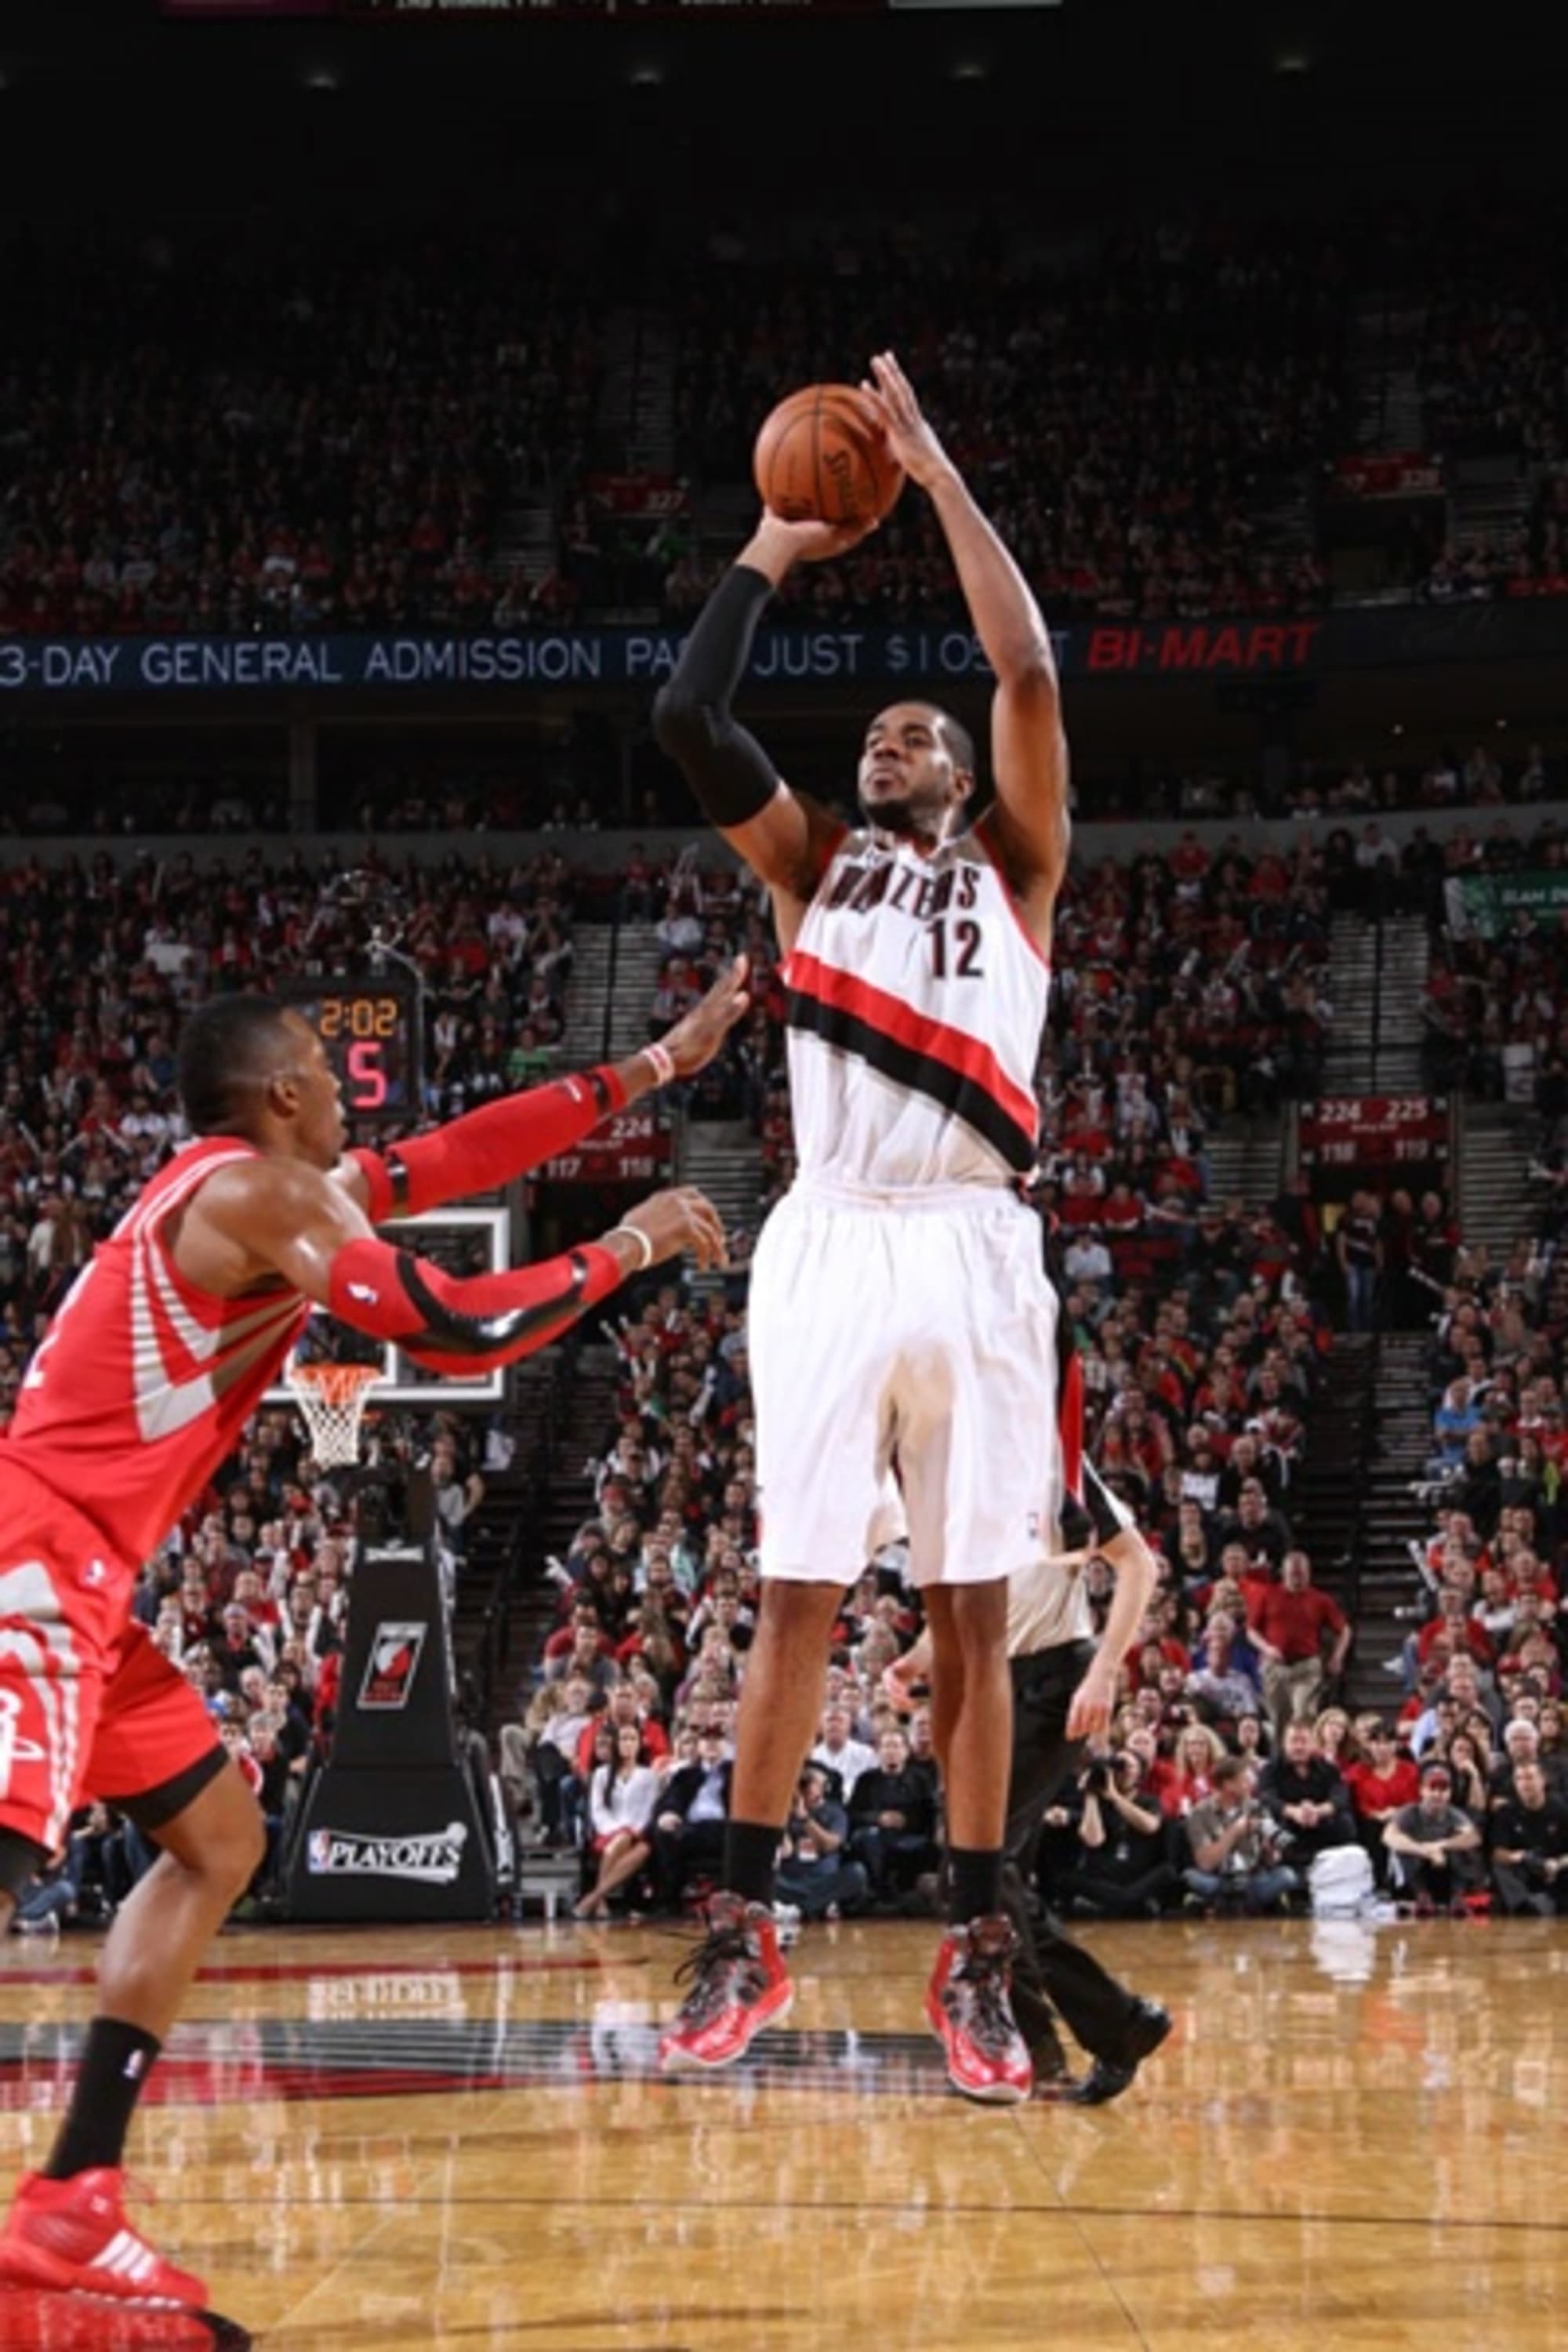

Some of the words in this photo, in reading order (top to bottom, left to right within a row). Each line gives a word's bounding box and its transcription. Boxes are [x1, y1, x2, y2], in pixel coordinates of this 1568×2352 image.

[140, 641, 343, 684] GENERAL
[364, 638, 601, 681] ADMISSION
[755, 633, 862, 676] JUST
[926, 919, 984, 978] 12
[320, 998, 397, 1036] 2:02
[348, 1040, 387, 1108] 5
[611, 1115, 653, 1138] 224
[1319, 1099, 1362, 1123] 224
[1385, 1098, 1428, 1121] 225
[329, 1839, 461, 1870] PLAYOFFS
